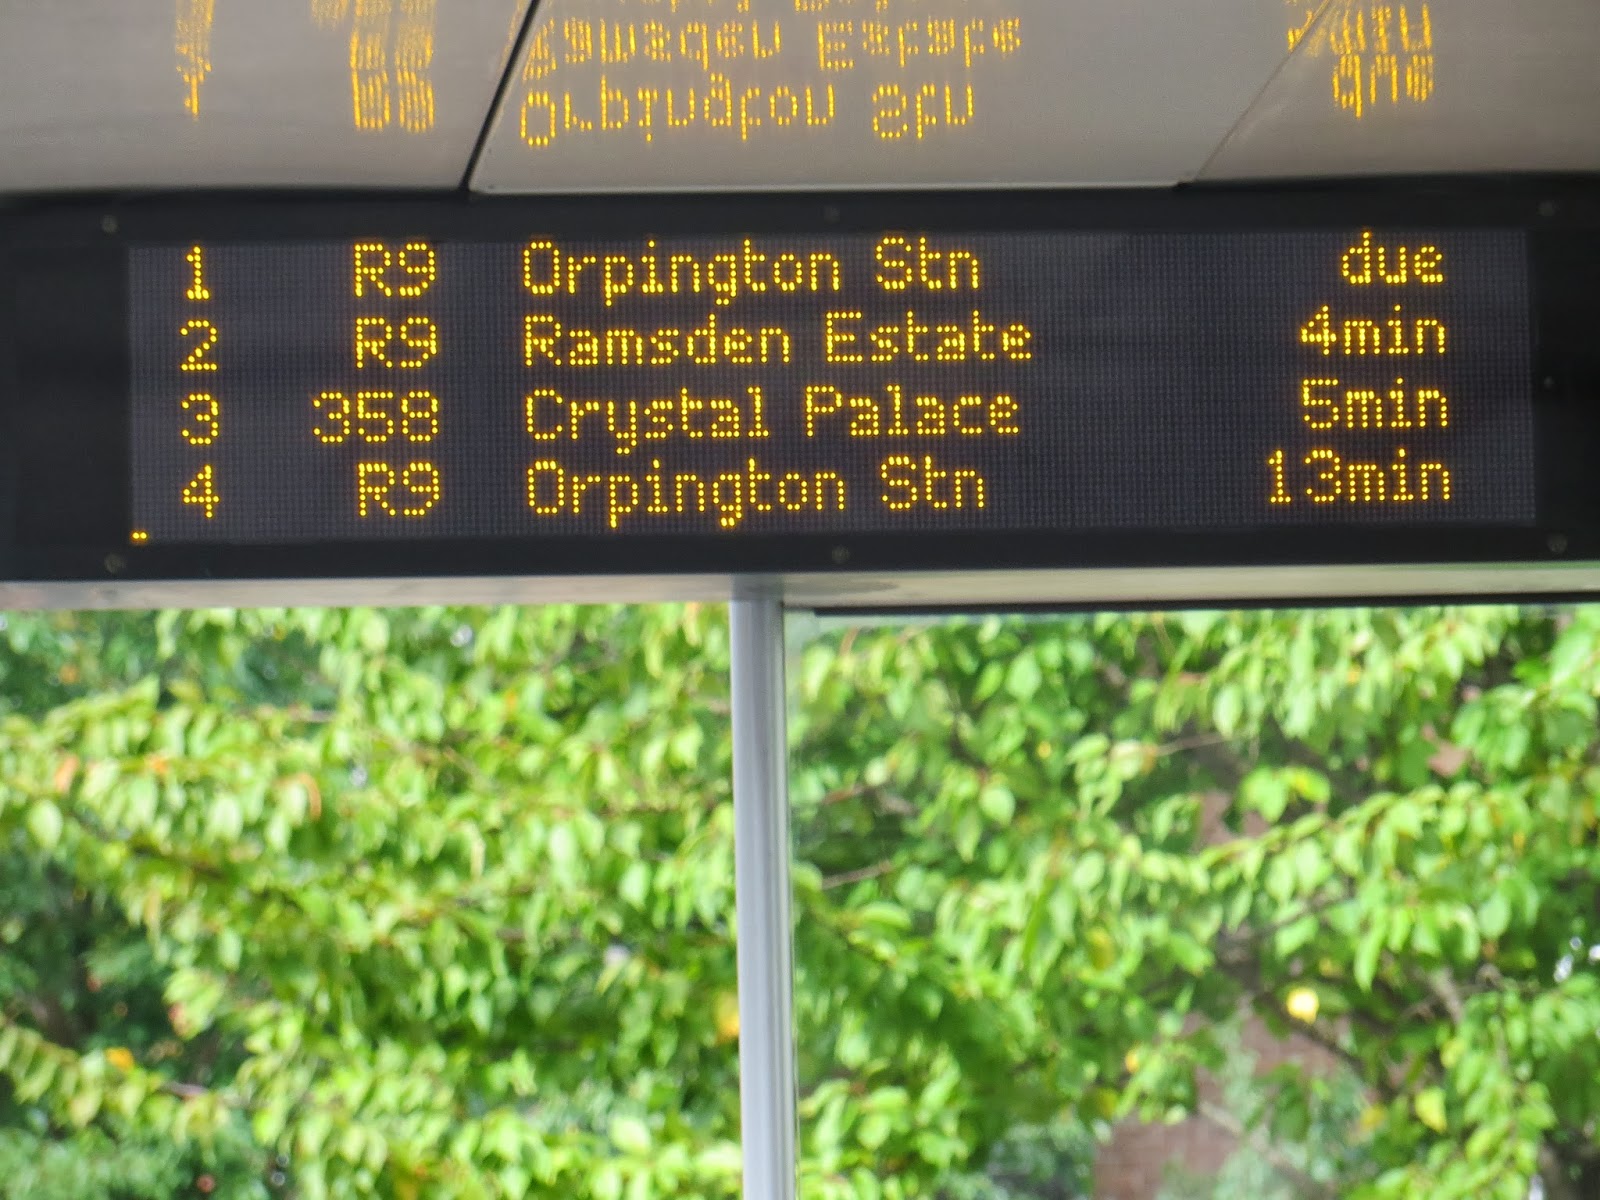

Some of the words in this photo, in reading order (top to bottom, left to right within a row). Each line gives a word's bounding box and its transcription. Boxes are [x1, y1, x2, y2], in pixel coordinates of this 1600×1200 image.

[185, 245, 210, 301] 1
[353, 242, 436, 298] R9
[522, 238, 842, 307] Orpington
[875, 236, 980, 291] Stn
[1341, 231, 1444, 285] due
[179, 319, 218, 372] 2
[354, 316, 438, 369] R9
[524, 313, 792, 367] Ramsden
[824, 309, 1033, 363] Estate
[1299, 304, 1447, 356] 4min
[181, 392, 219, 445] 3
[312, 390, 439, 444] 358
[525, 385, 770, 455] Crystal
[805, 384, 1020, 437] Palace
[1301, 377, 1449, 430] 5min
[181, 464, 220, 519] 4
[357, 460, 440, 517] R9
[526, 457, 846, 529] Orpington
[879, 455, 985, 510] Stn
[1266, 447, 1451, 505] 13min
